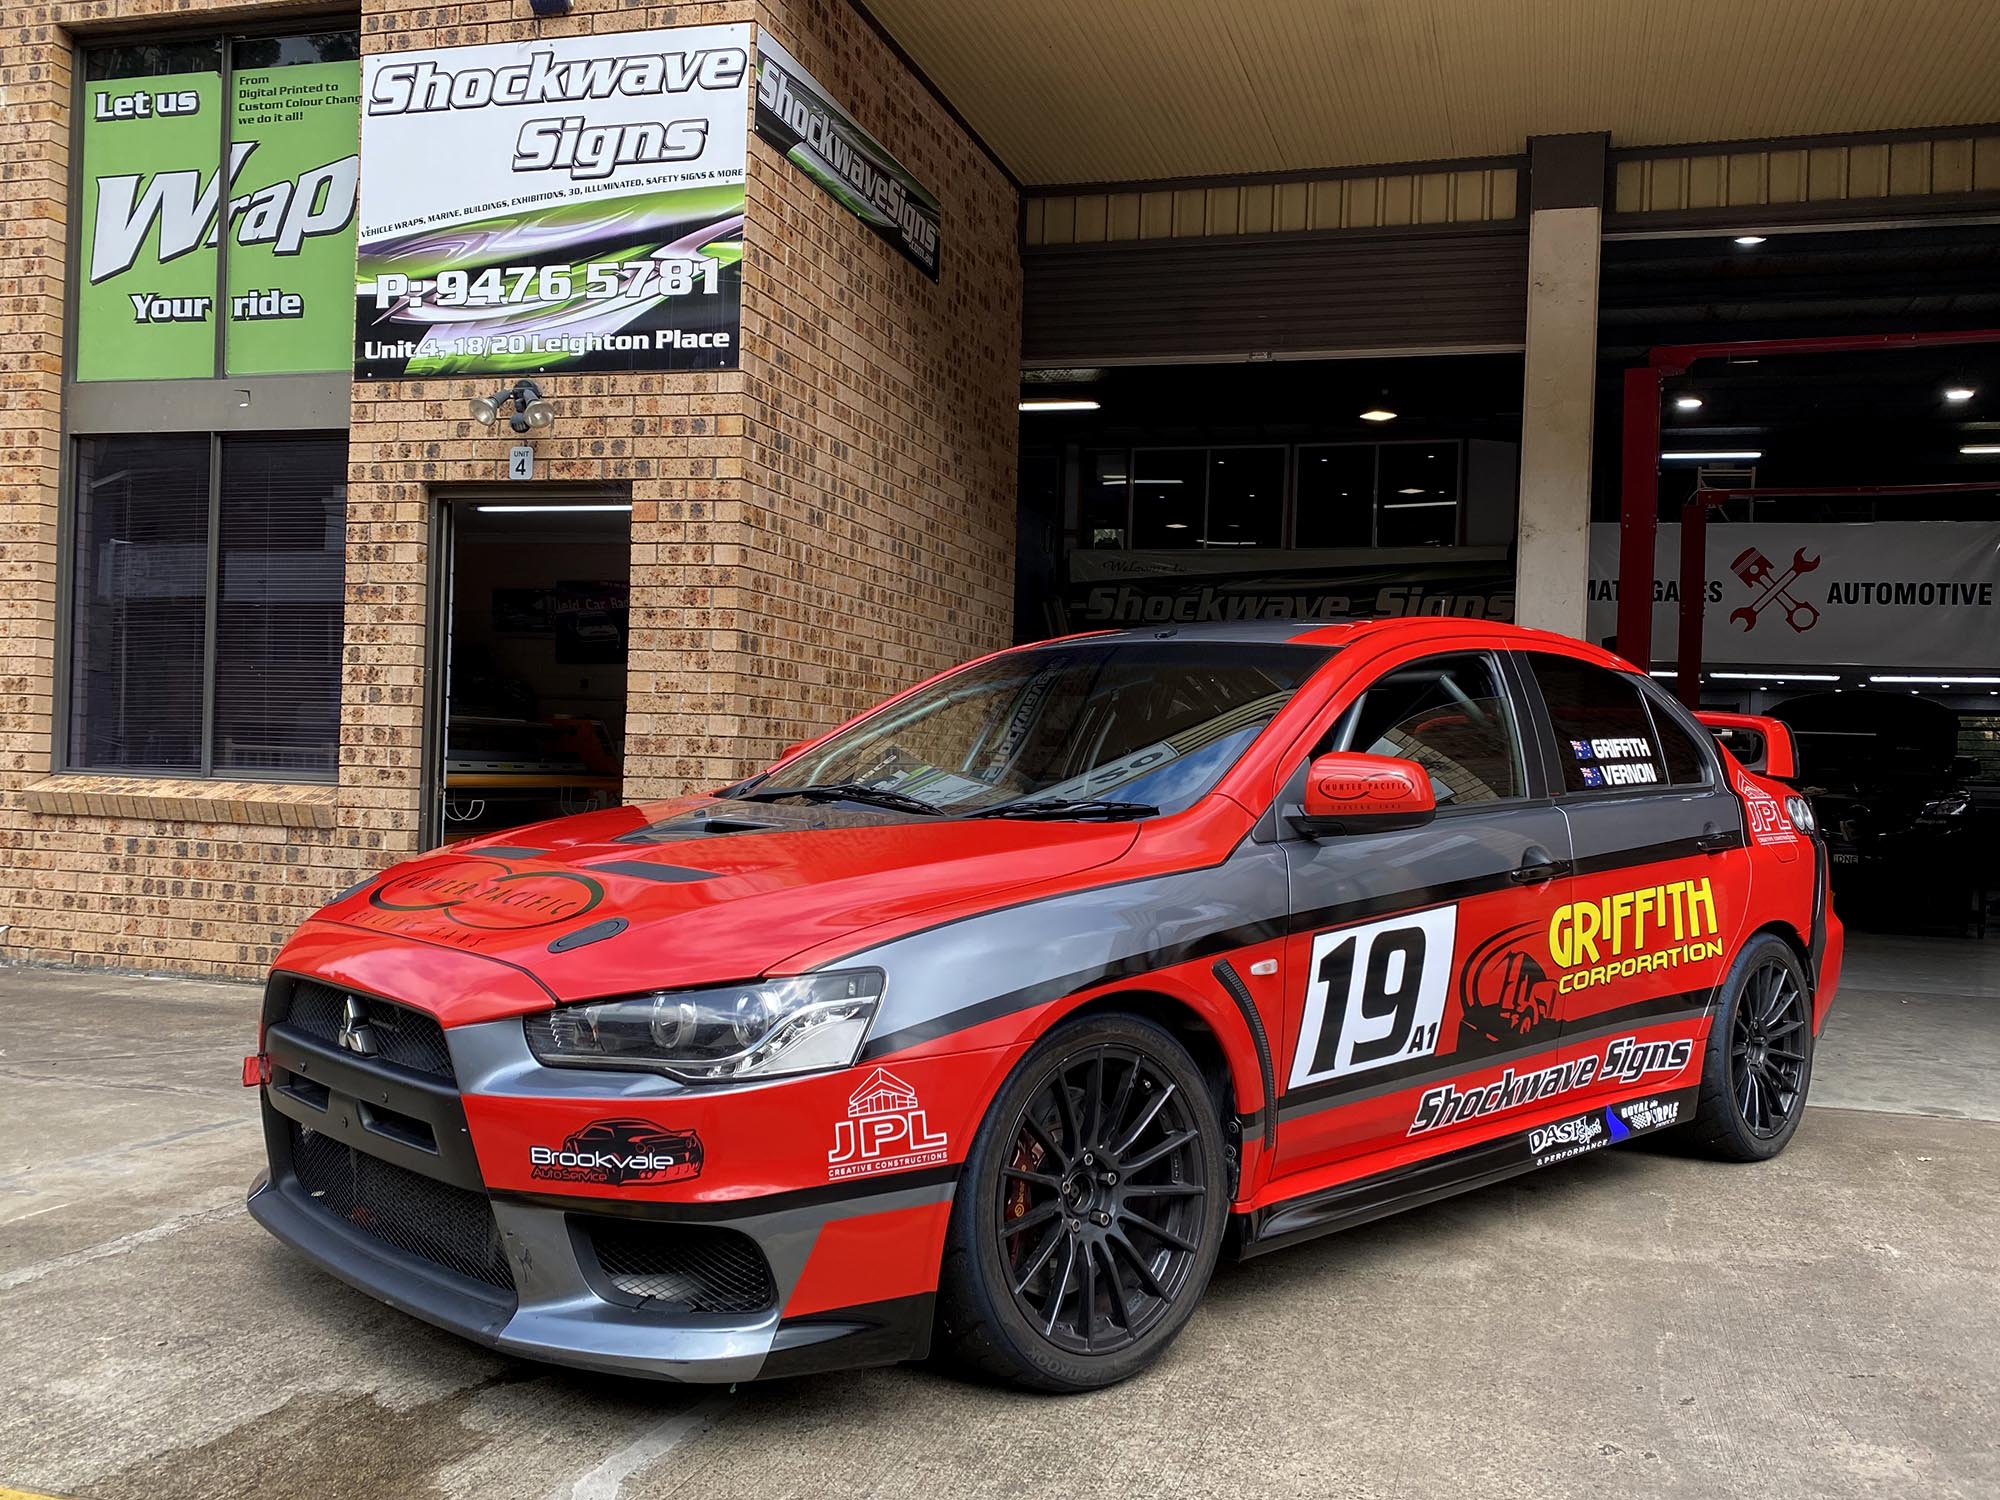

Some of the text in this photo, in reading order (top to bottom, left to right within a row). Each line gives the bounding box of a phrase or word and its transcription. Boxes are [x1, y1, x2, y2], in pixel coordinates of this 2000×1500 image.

[239, 76, 270, 86] From
[239, 83, 339, 100] Digital Printed to
[368, 47, 747, 116] Shockwave
[95, 89, 200, 122] Let us
[238, 101, 283, 112] Custom
[285, 97, 324, 108] Colour
[238, 111, 304, 125] we do it all!
[512, 116, 709, 180] Signs
[90, 140, 359, 285] Wrap
[361, 168, 744, 238] VEHICLE WRAPS, MARINE, BUILDINGS, EXHIBITIONS, 3D, ILLUMINATED, SAFETY SIGNS & MORE
[375, 257, 721, 309] P: 9476 5781
[127, 289, 305, 324] Your ride
[364, 327, 731, 360] Unit 4, 18/20 Leighton Place
[515, 458, 527, 476] 4
[1085, 585, 1351, 622] Shockwave
[1827, 581, 1993, 606] AUTOMOTIVE
[1591, 738, 1652, 759] GRIFFITH
[1325, 782, 1407, 791] HUNTER PACIFIC
[1600, 763, 1658, 786] VERNON
[1747, 800, 1792, 832] JPL
[395, 876, 577, 915] HUNTER PACIFIC
[1548, 876, 1718, 969] GRIFFITH
[1558, 937, 1724, 995] CORPORATION
[1307, 925, 1427, 1076] 19
[1406, 1021, 1437, 1055] A1
[1406, 1035, 1694, 1137] Shockwave Signs
[828, 1110, 947, 1163] JPL
[1528, 1116, 1587, 1154] DASH
[530, 1146, 675, 1170] Brookvale
[828, 1151, 948, 1177] CREATIVE CONSTRUCTIONS
[1536, 1138, 1608, 1167] & PERFORMANCE
